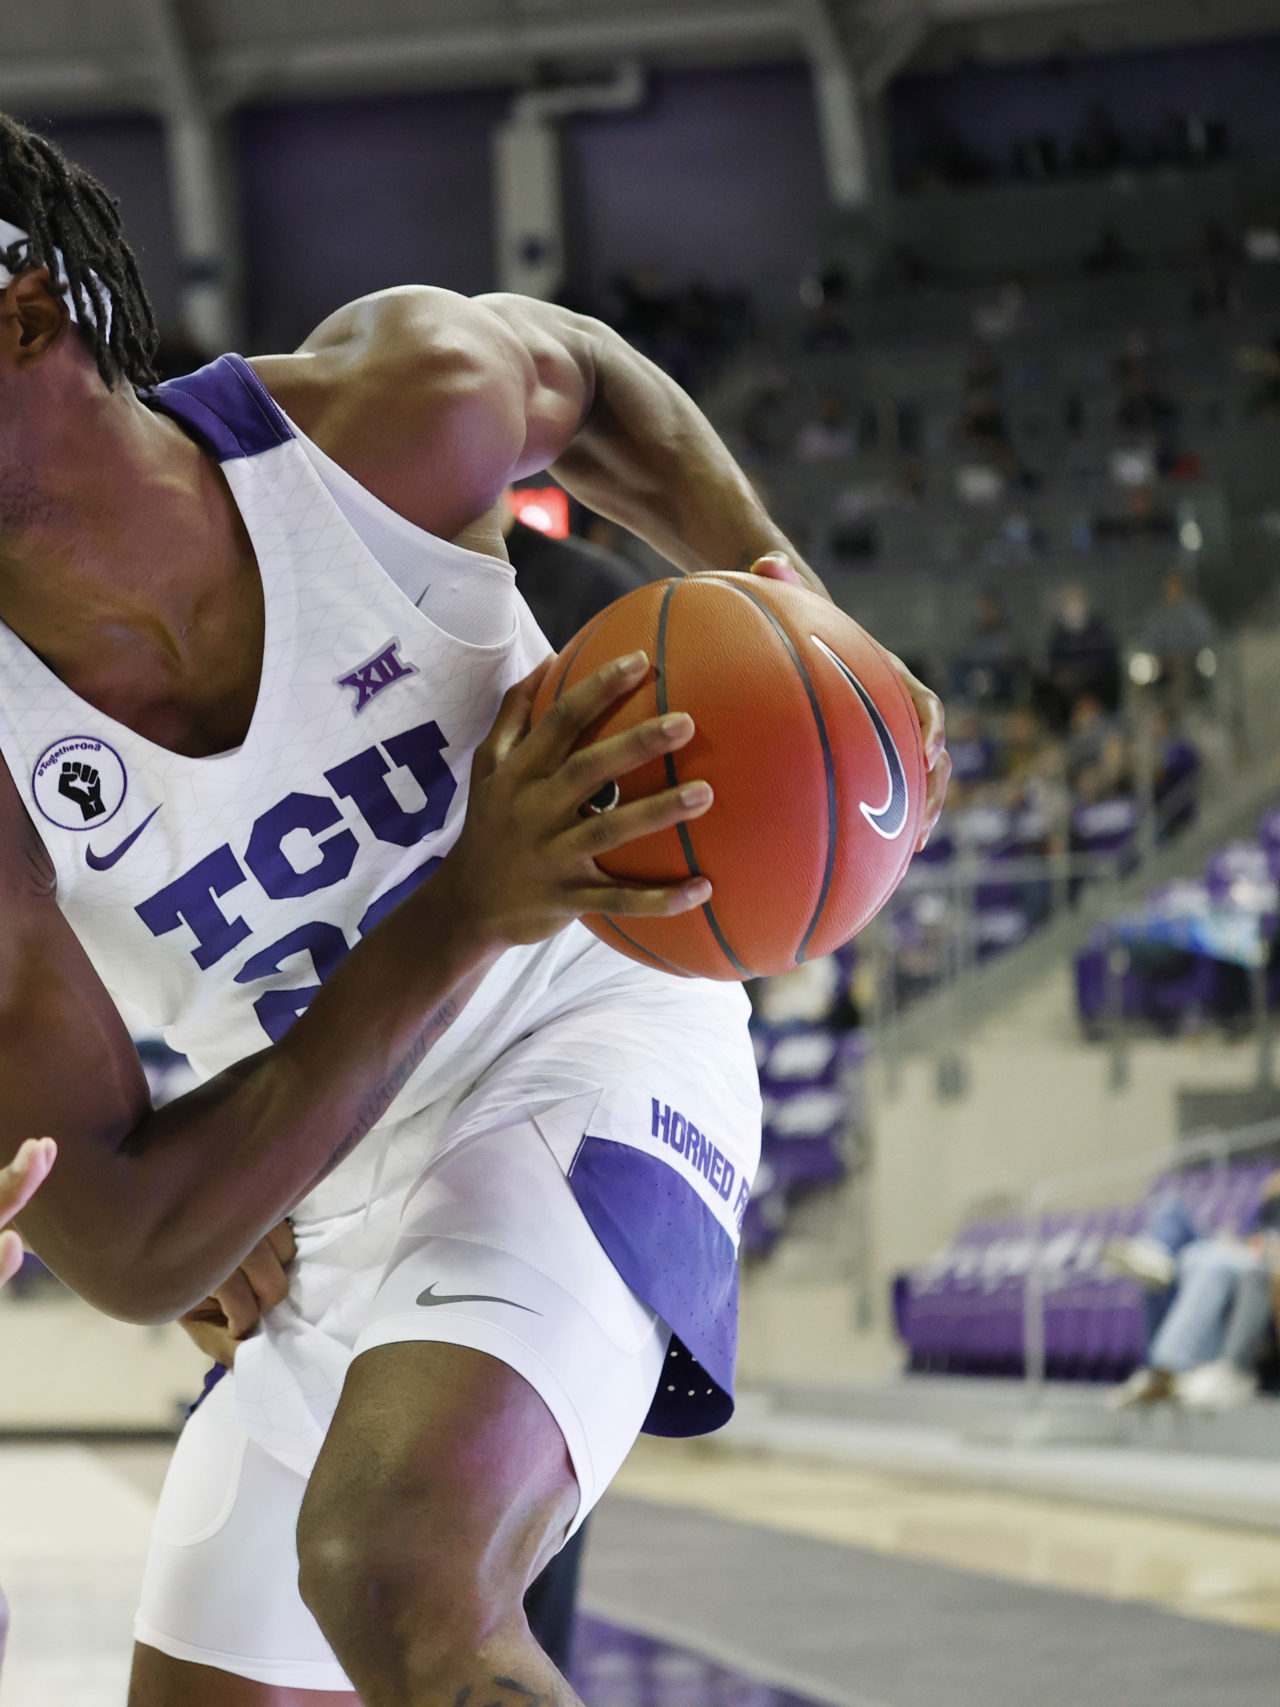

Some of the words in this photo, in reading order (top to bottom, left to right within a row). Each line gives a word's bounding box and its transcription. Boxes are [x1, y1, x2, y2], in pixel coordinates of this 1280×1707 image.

[338, 642, 414, 713] XII
[134, 720, 458, 971] TCU
[651, 1097, 736, 1202] HORNED
